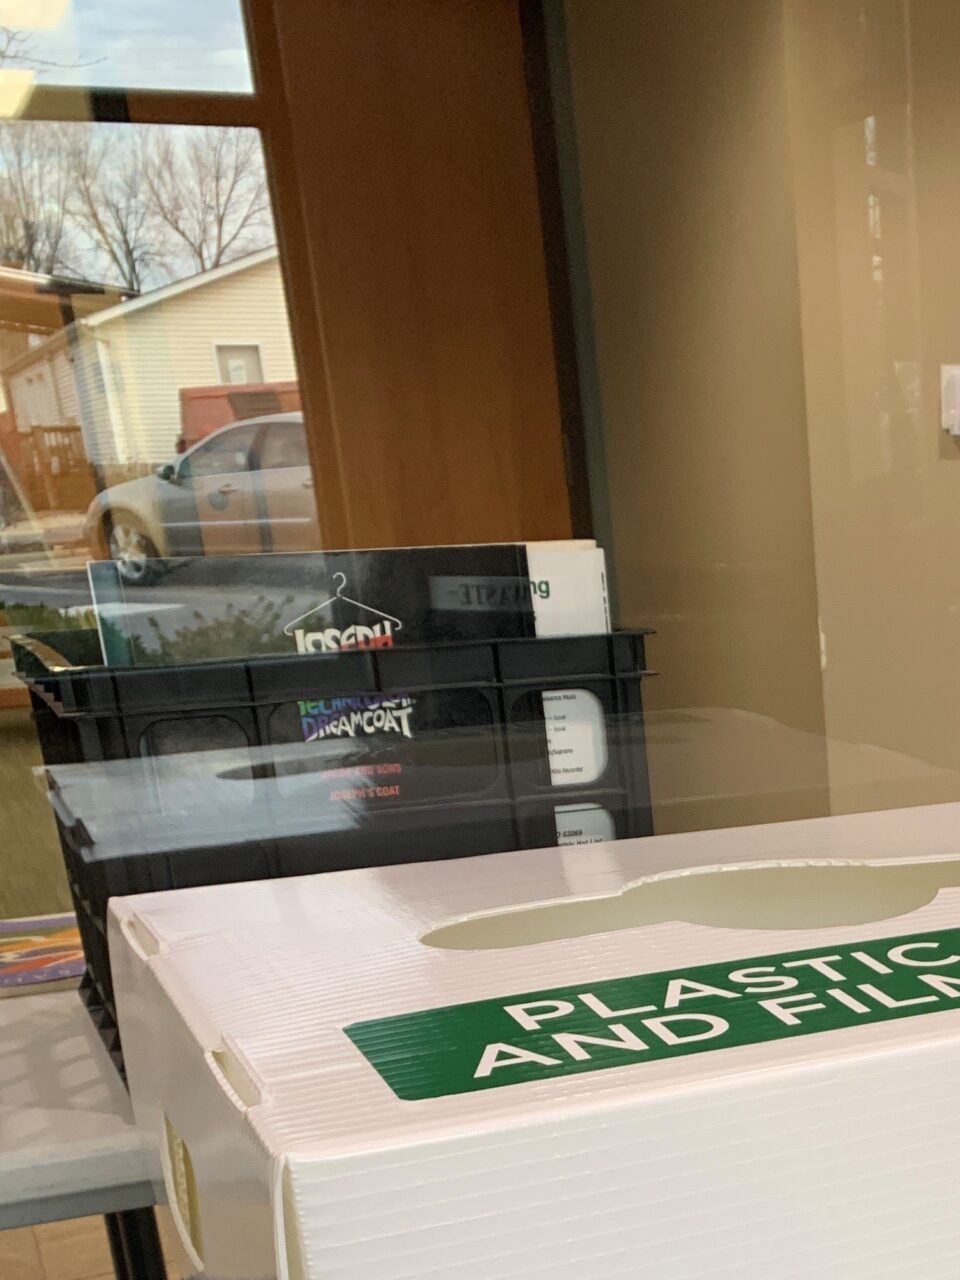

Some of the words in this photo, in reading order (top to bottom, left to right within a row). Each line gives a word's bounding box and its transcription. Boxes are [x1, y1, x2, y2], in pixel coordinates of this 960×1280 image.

[300, 707, 414, 743] DREAMCOAT
[376, 785, 400, 798] COAT
[473, 1013, 730, 1079] AND
